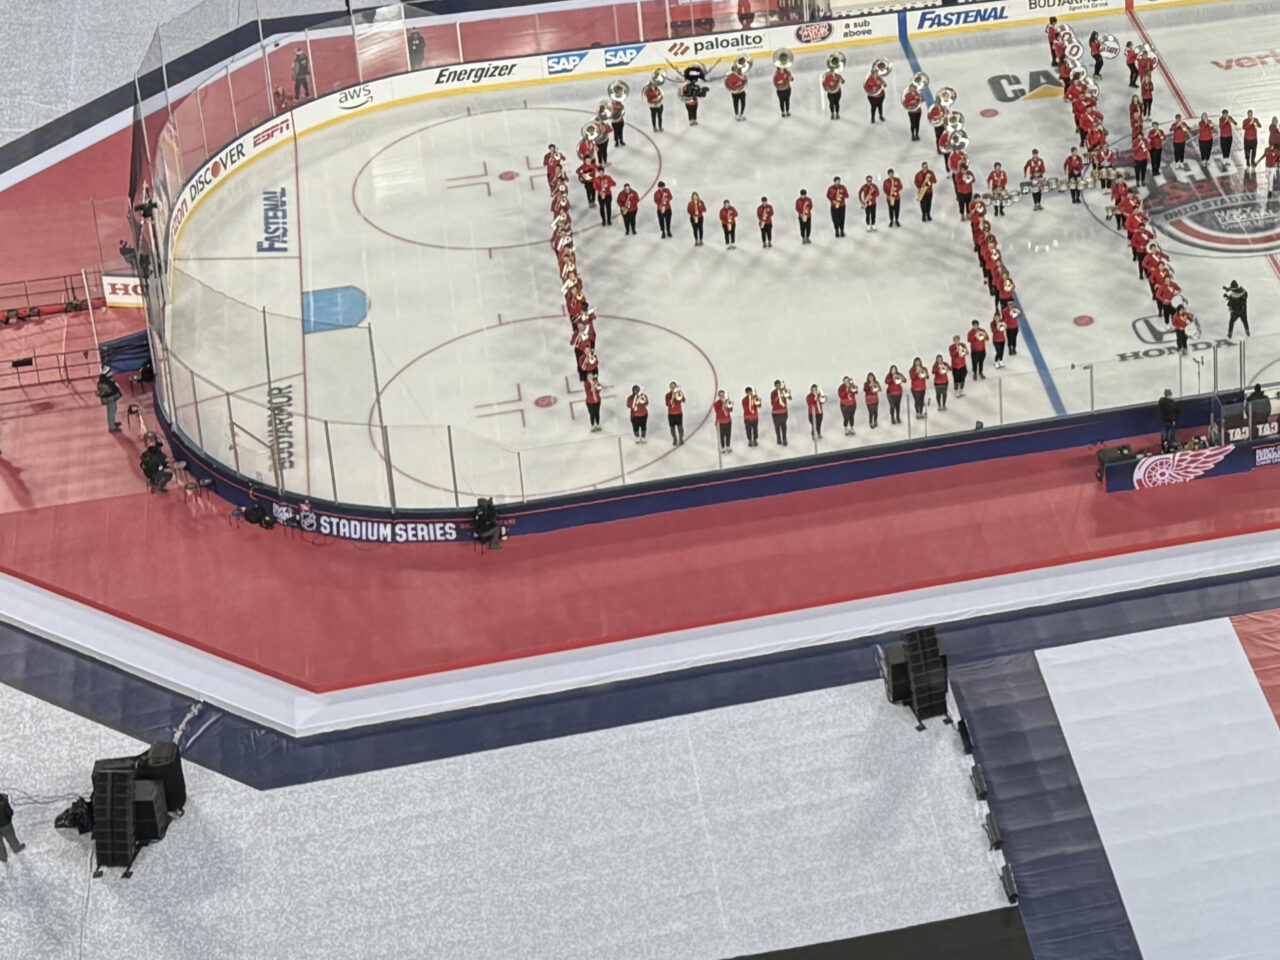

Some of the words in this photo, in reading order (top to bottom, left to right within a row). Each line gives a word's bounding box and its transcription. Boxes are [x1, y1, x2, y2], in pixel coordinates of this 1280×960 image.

[853, 19, 870, 28] sub
[917, 6, 1009, 29] FASTENAL
[694, 33, 763, 54] paloalto
[843, 28, 872, 38] above
[548, 55, 581, 73] SAP
[605, 48, 638, 65] SAP
[435, 62, 517, 84] Energizer
[338, 84, 372, 103] aws
[987, 69, 1066, 103] CA
[188, 142, 246, 201] DISCOVER
[320, 515, 393, 543] STADIUM
[395, 522, 457, 543] SERIES
